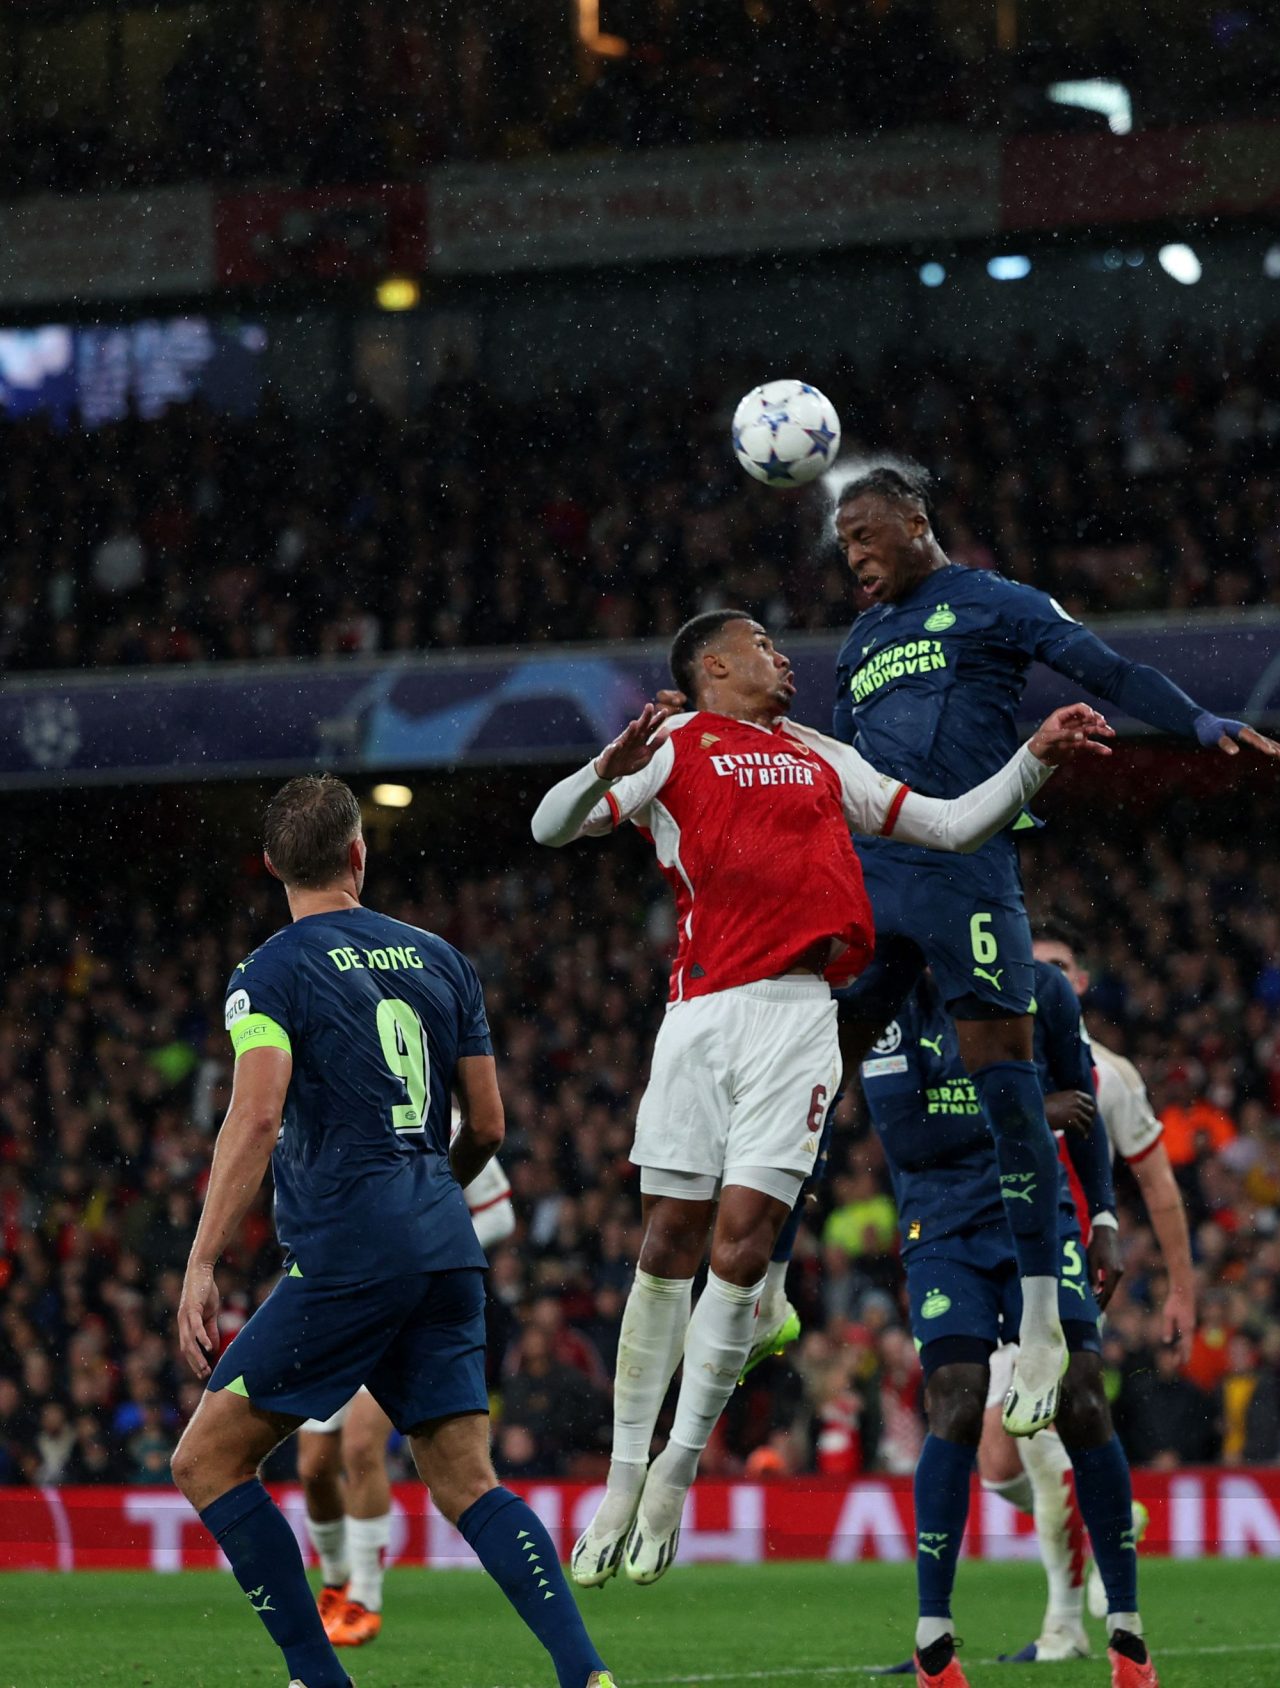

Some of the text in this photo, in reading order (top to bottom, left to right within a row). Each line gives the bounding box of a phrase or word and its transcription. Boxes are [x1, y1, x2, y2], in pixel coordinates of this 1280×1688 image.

[850, 639, 943, 691] BRAINPORT
[853, 652, 947, 703] EINDHOVEN
[735, 765, 814, 788] LY BETTER
[327, 946, 423, 972] DE JONG
[969, 912, 998, 964] 6
[376, 998, 431, 1135] 9
